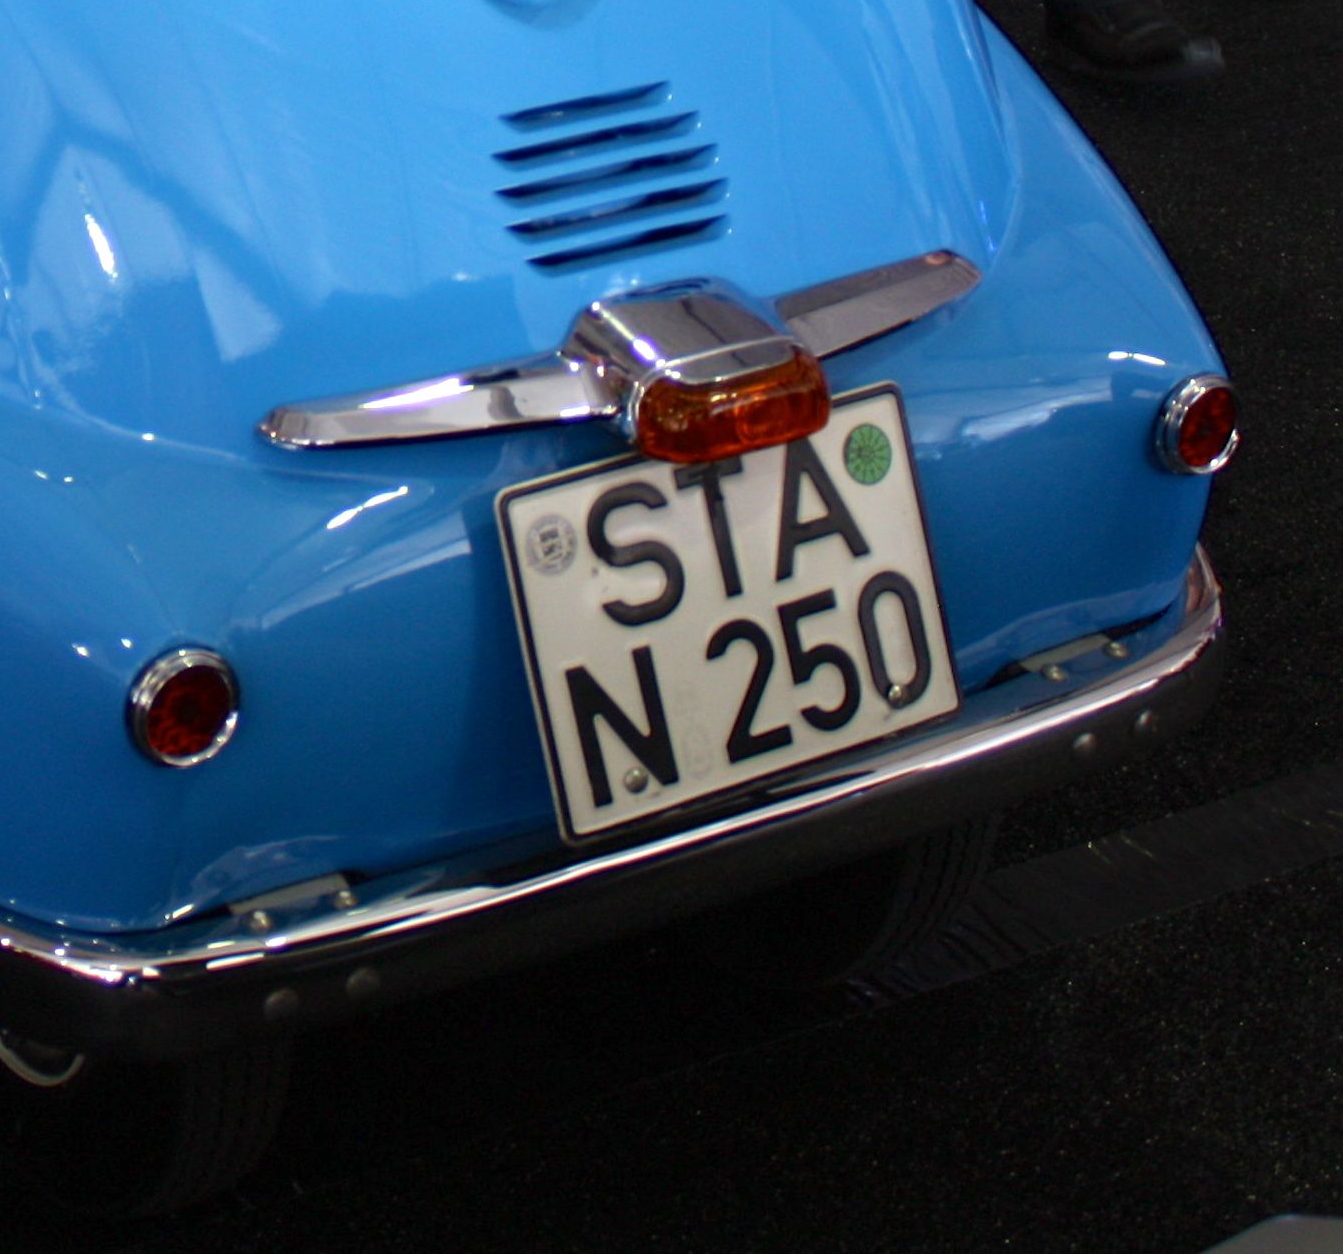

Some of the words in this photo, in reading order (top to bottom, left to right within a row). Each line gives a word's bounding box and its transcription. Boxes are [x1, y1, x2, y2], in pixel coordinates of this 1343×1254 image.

[587, 436, 870, 627] STA
[565, 647, 679, 808] N
[706, 571, 932, 764] 250
